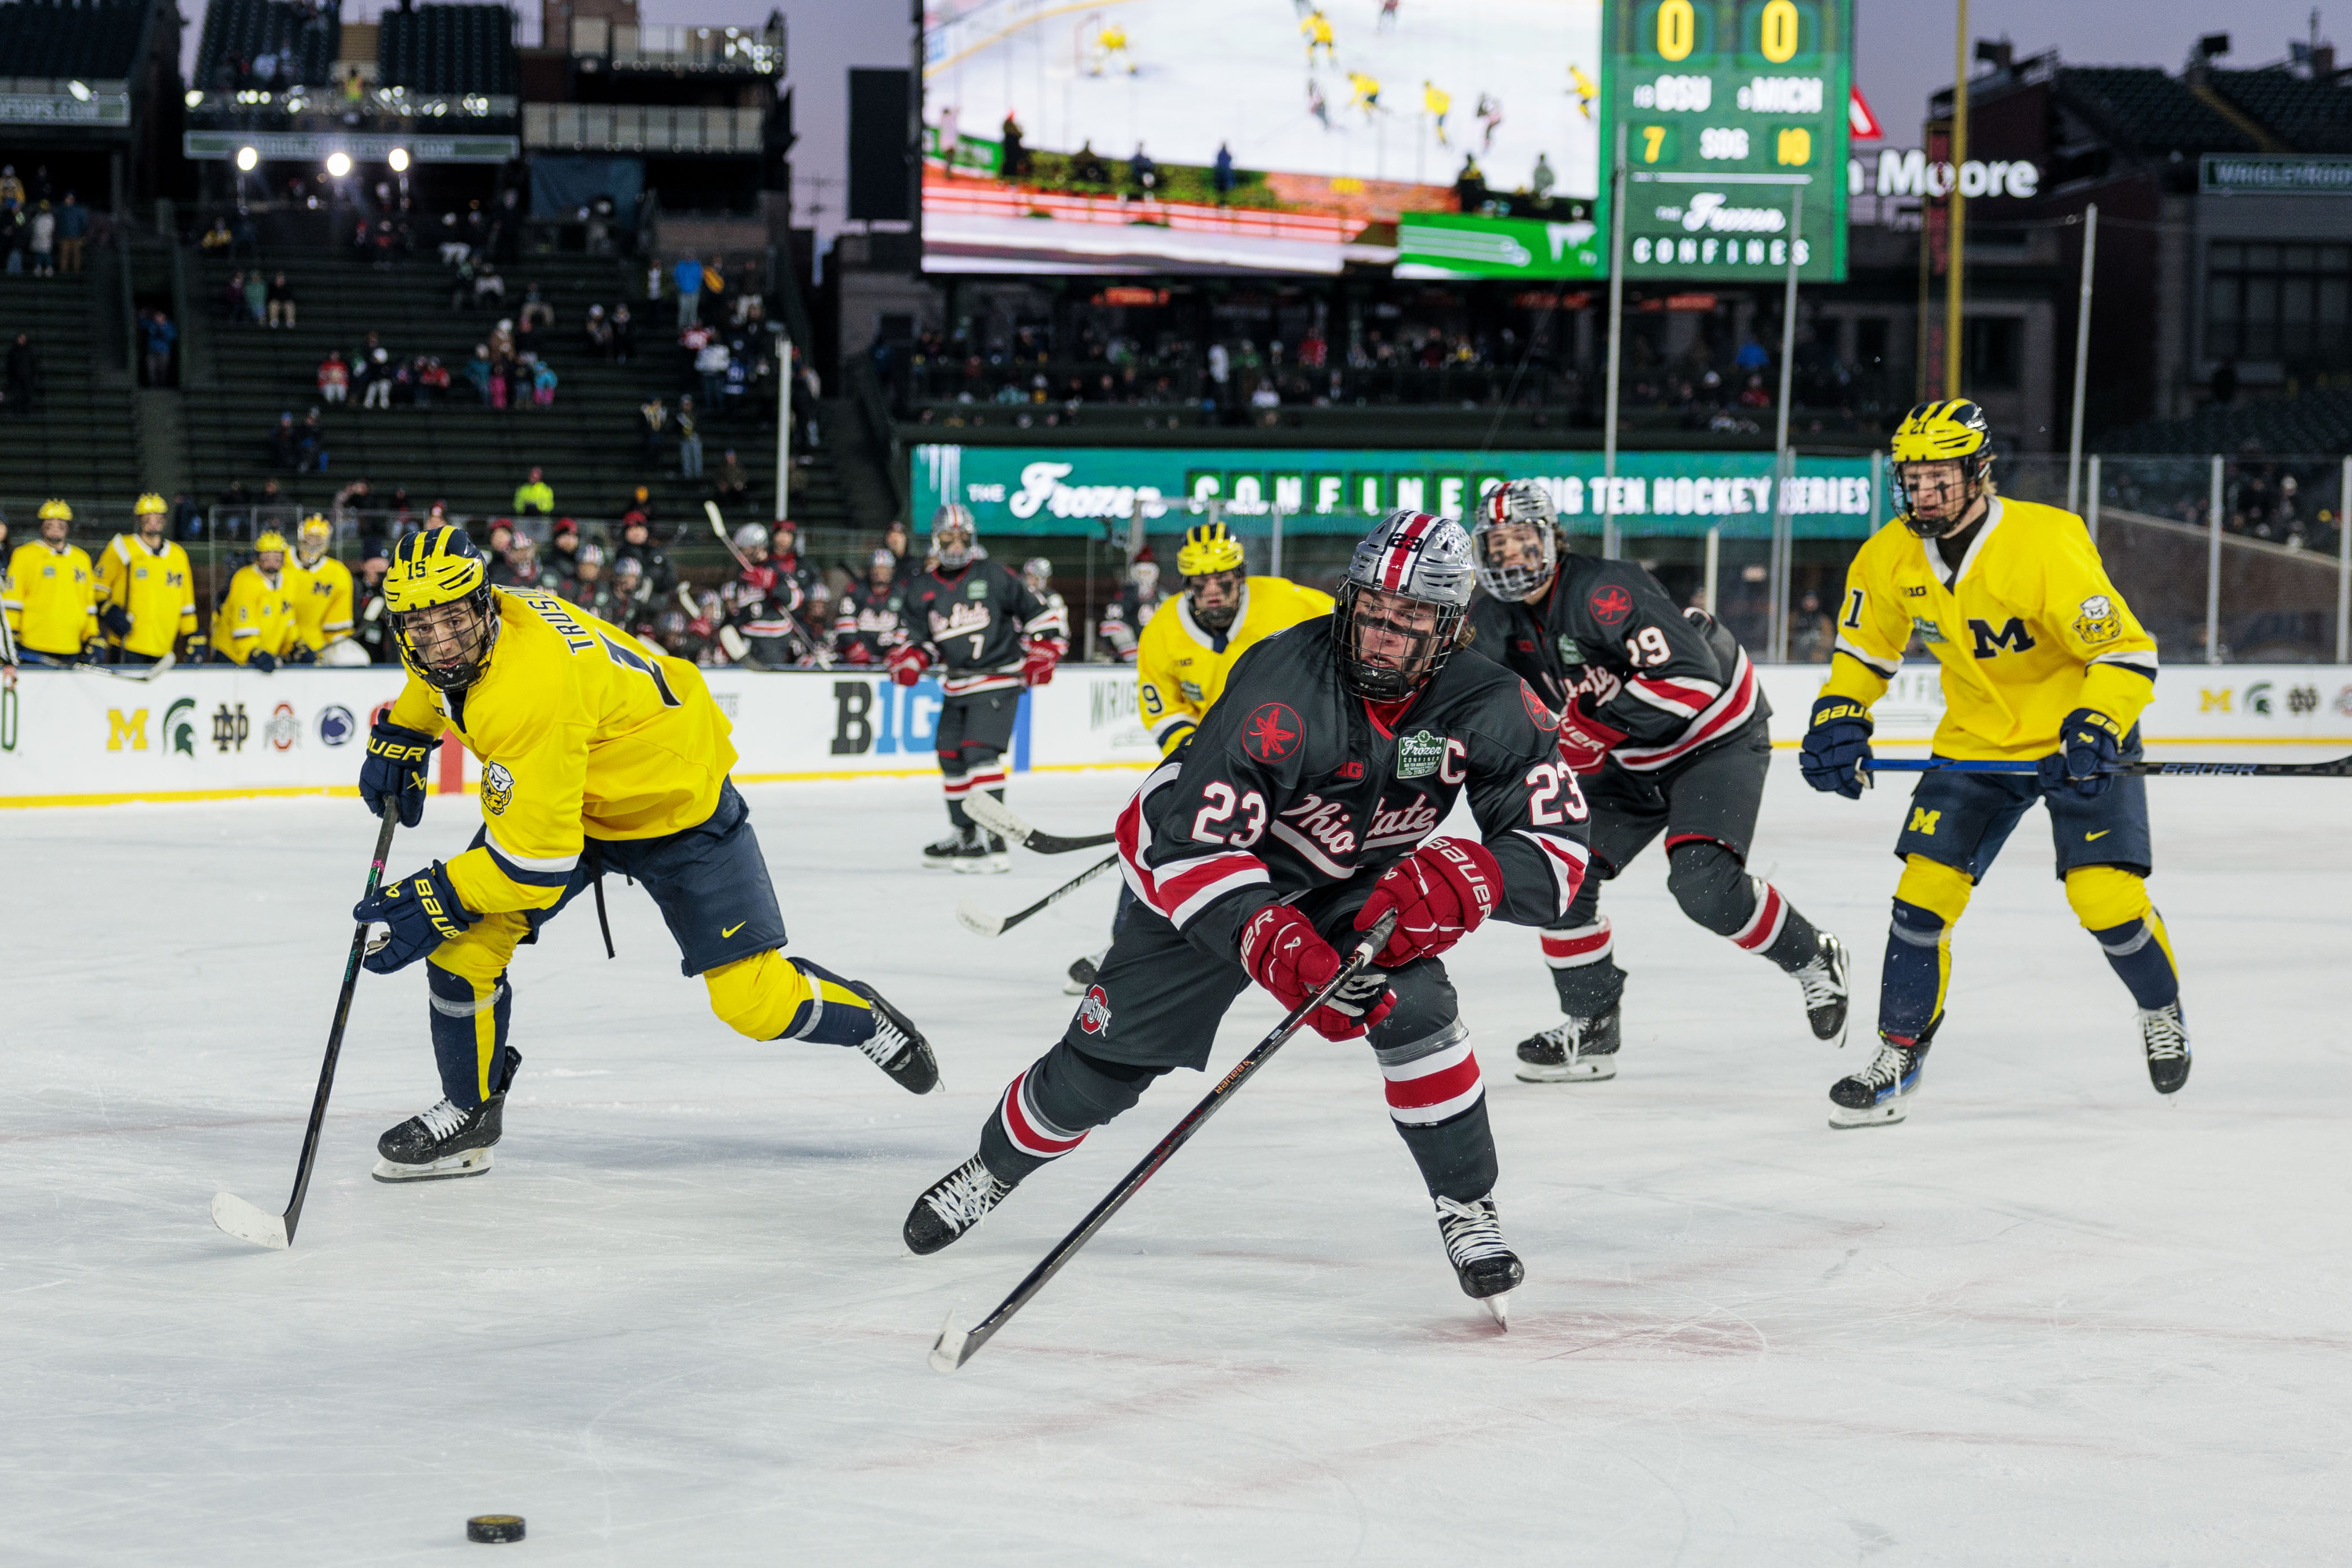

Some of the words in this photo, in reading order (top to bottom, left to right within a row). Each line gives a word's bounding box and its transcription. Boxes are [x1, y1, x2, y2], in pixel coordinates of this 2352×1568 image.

[1657, 0, 1694, 61] 0
[1761, 0, 1798, 63] 0
[1642, 126, 1666, 164] 7
[1877, 149, 2039, 198] Moore
[1632, 237, 1810, 266] CONFINES
[967, 483, 1006, 503] THE
[1588, 476, 1647, 515] TEN
[1653, 476, 1773, 515] HOCKEY
[1779, 477, 1871, 516] SERIES
[1389, 532, 1424, 553] 23
[408, 560, 426, 580] 15
[1842, 589, 1865, 629] 1
[968, 633, 985, 660] 7
[1967, 616, 2037, 660] M
[2199, 689, 2233, 713] M
[107, 709, 148, 750] M
[366, 732, 426, 763] UER
[1401, 739, 1442, 756] Frozen
[1560, 706, 1606, 753] UER
[1439, 736, 1467, 785] C
[2160, 762, 2257, 776] BAUER
[1525, 760, 1590, 826] 23
[1189, 779, 1269, 849] 23
[1364, 792, 1438, 837] tate
[1907, 808, 1942, 836] M
[1425, 837, 1491, 924] BAUER
[414, 878, 462, 939] BAUE
[1214, 1065, 1245, 1094] BAUER
